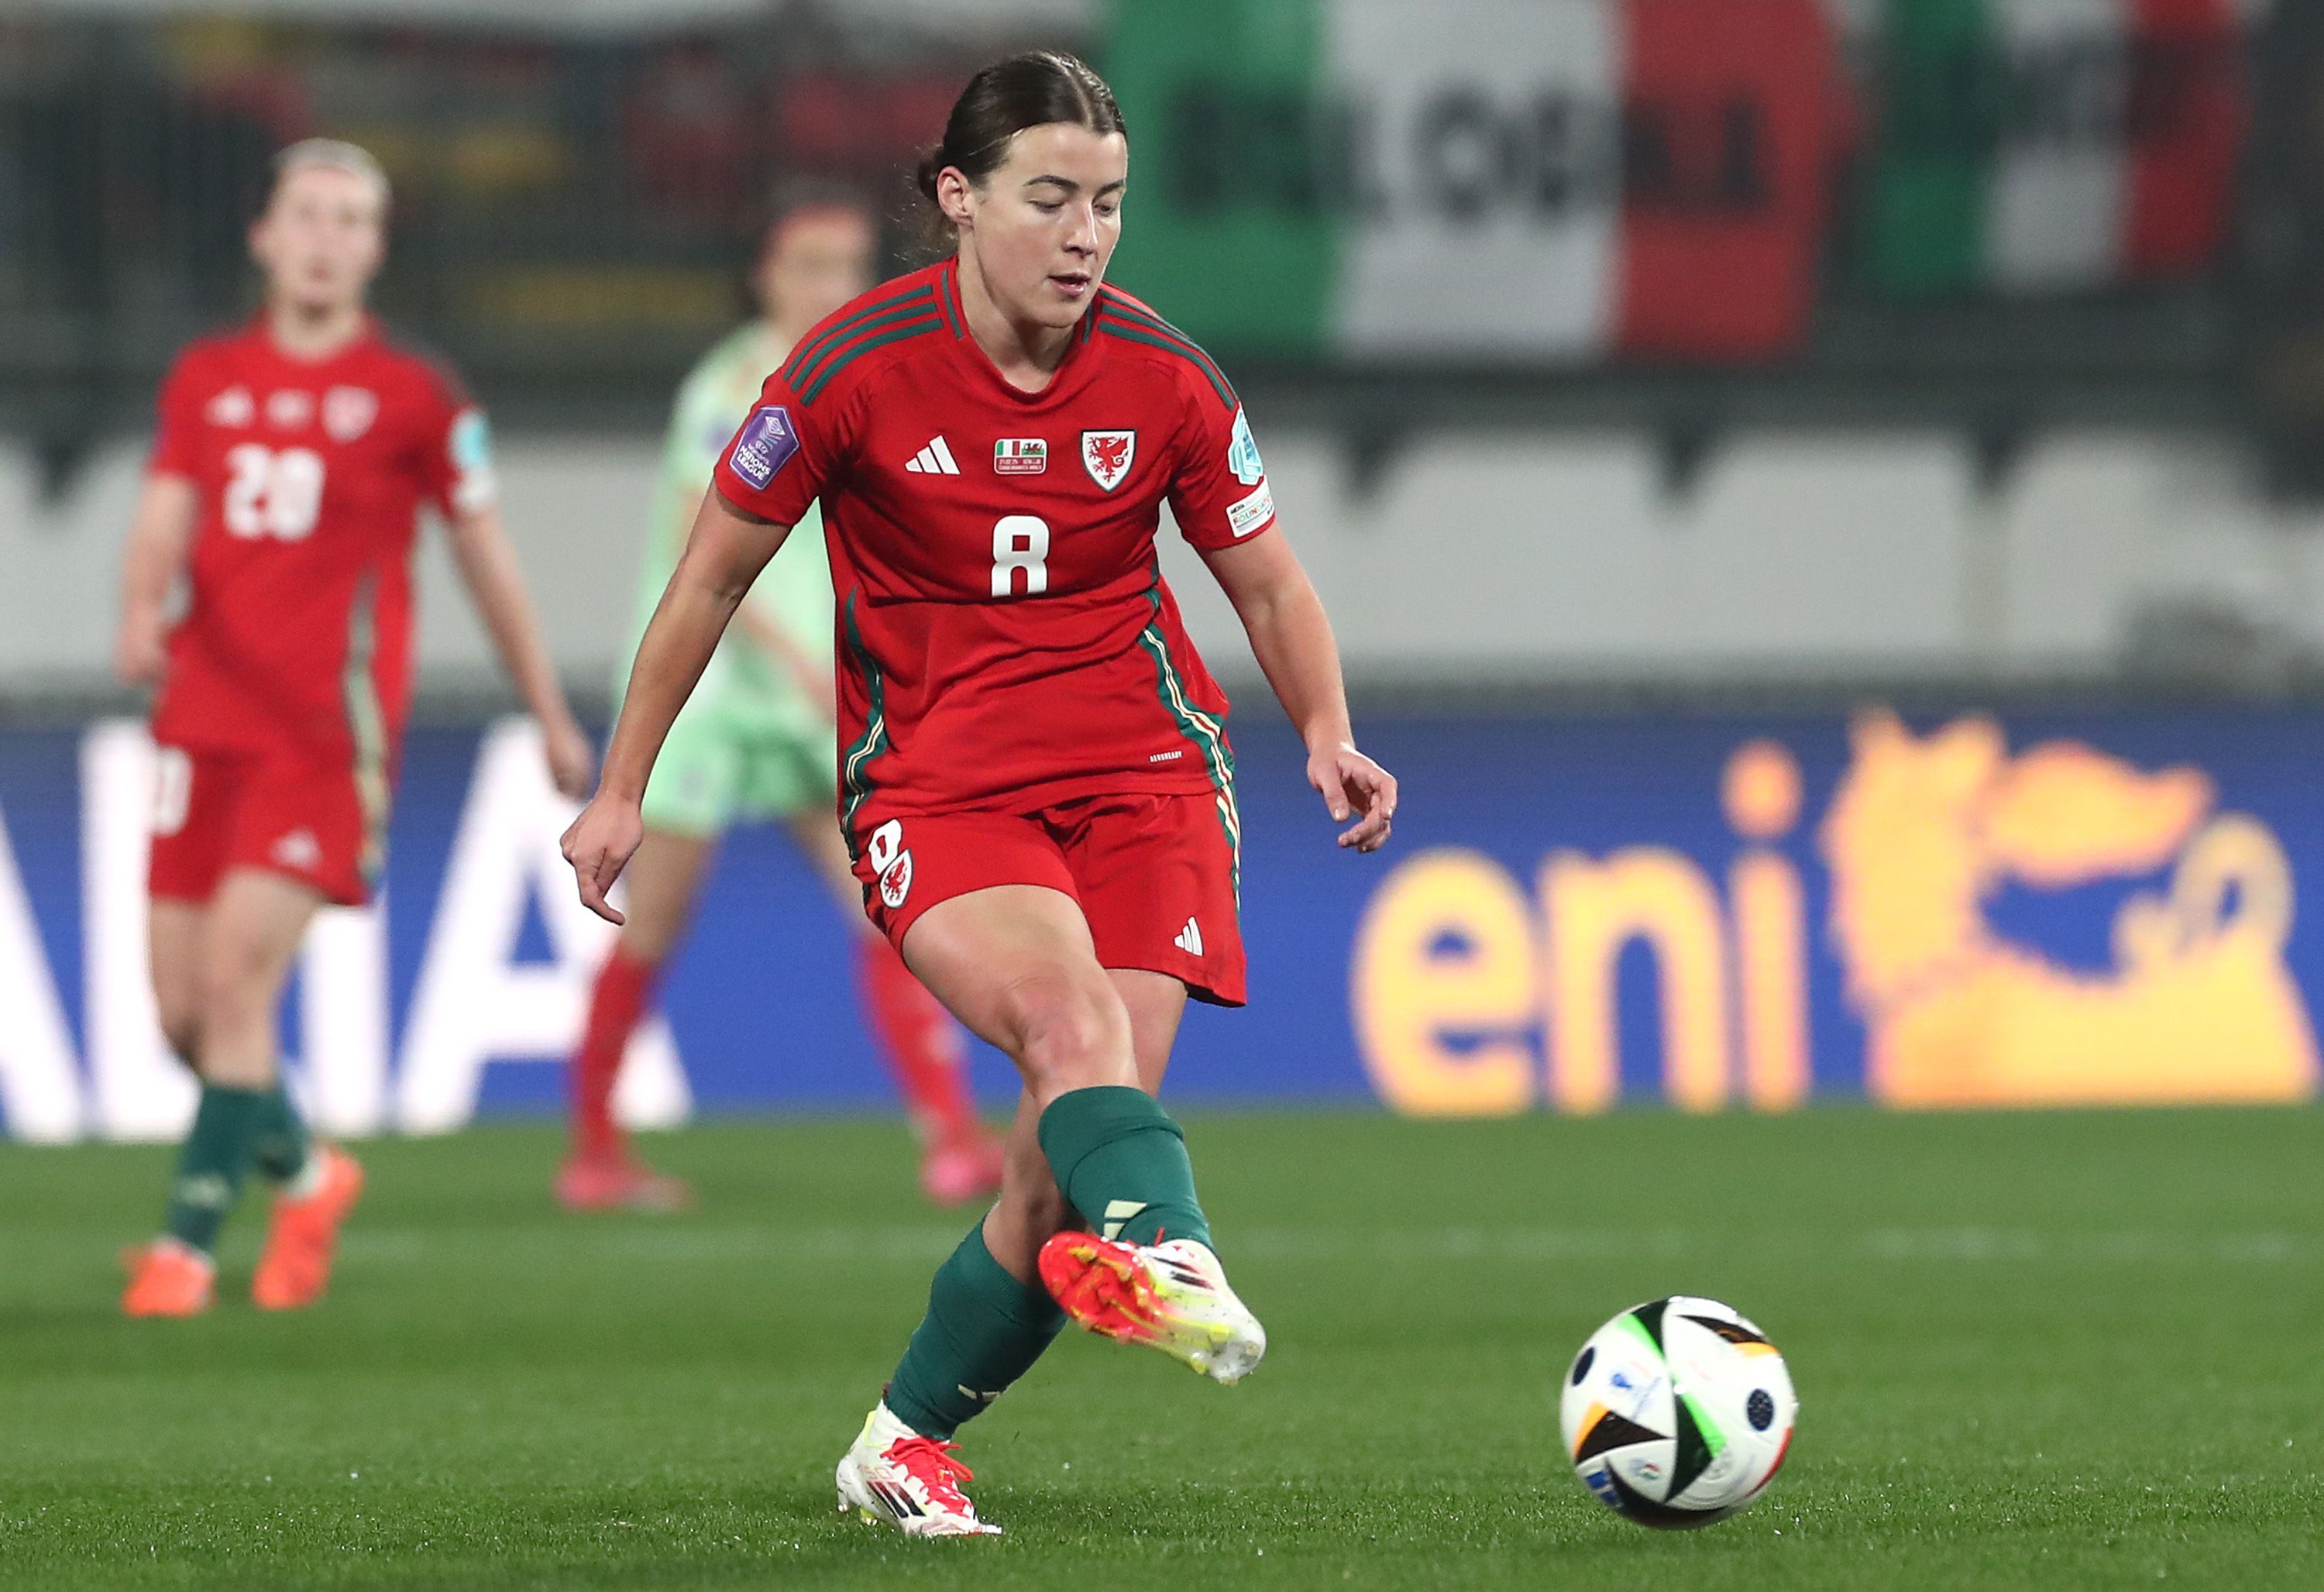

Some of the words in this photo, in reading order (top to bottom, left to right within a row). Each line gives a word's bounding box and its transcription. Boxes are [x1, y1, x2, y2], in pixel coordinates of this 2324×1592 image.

[223, 442, 325, 541] 20
[737, 453, 765, 480] LEAGUE
[739, 445, 772, 475] NATIONS
[992, 515, 1050, 597] 8
[1351, 738, 1811, 1115] eni
